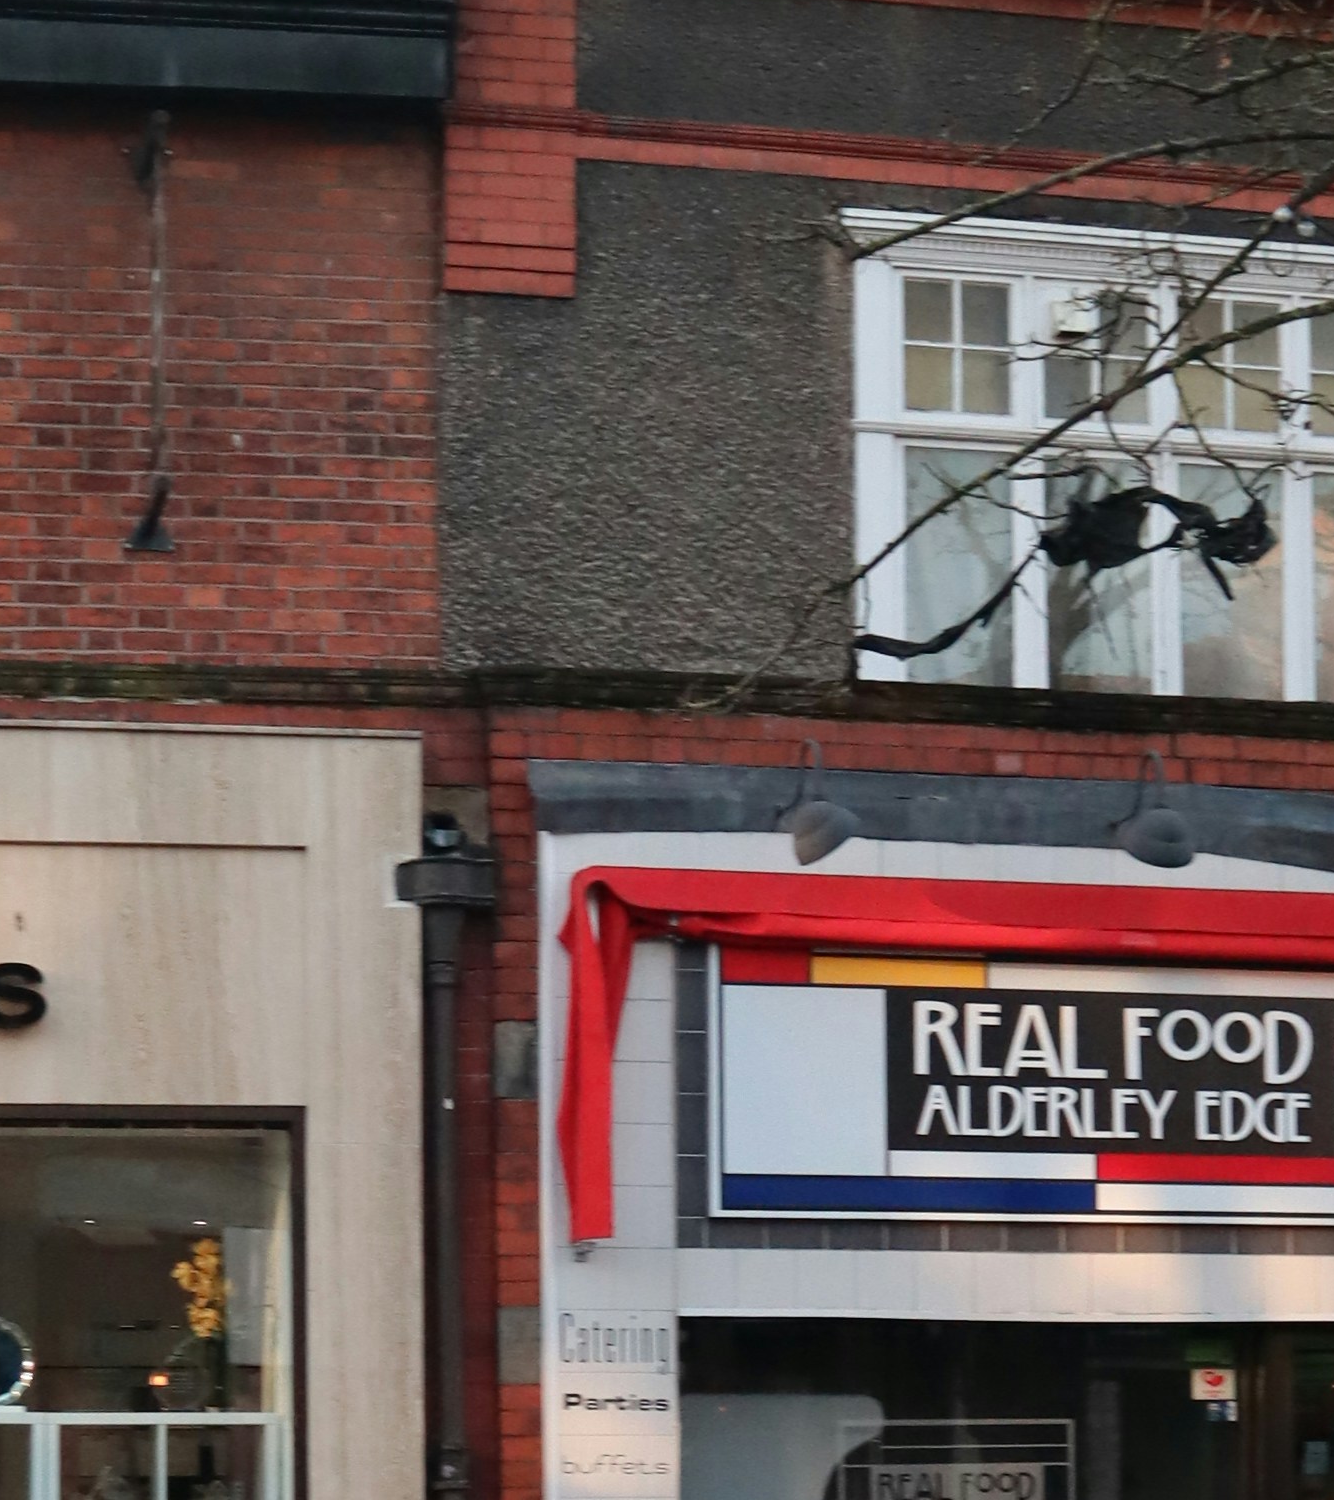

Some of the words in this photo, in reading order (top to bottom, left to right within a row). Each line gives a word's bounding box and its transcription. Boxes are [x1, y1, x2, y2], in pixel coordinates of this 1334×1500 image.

[913, 1000, 1108, 1079] REAL
[1123, 1007, 1315, 1085] FOOD
[916, 1084, 1178, 1140] ALDERLEY
[1195, 1091, 1312, 1143] EDGE
[558, 1312, 670, 1374] Catering
[563, 1393, 670, 1411] Parties
[561, 1453, 671, 1475] buffets
[960, 1471, 1036, 1500] FOOD
